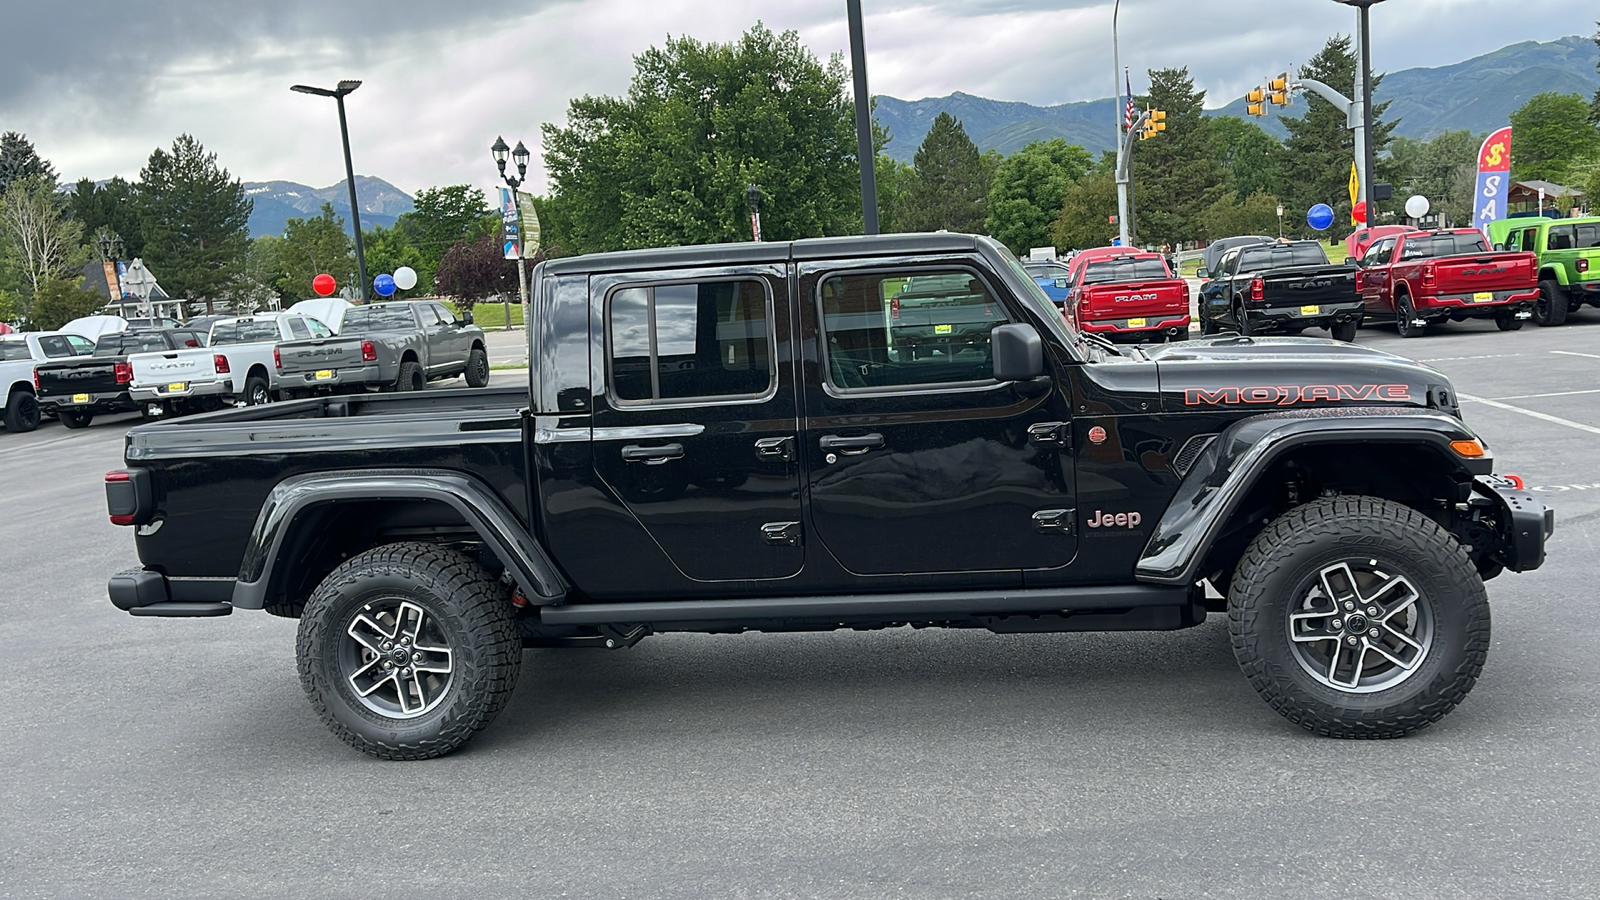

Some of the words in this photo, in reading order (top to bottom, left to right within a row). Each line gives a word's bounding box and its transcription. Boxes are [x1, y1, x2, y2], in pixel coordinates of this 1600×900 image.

[1462, 267, 1507, 276] RAM
[1288, 280, 1332, 289] RAM
[1114, 293, 1157, 303] RAM
[298, 347, 343, 358] RAM
[150, 359, 195, 370] RAM
[1185, 384, 1411, 406] MOJAVE
[1087, 510, 1142, 529] Jeep
